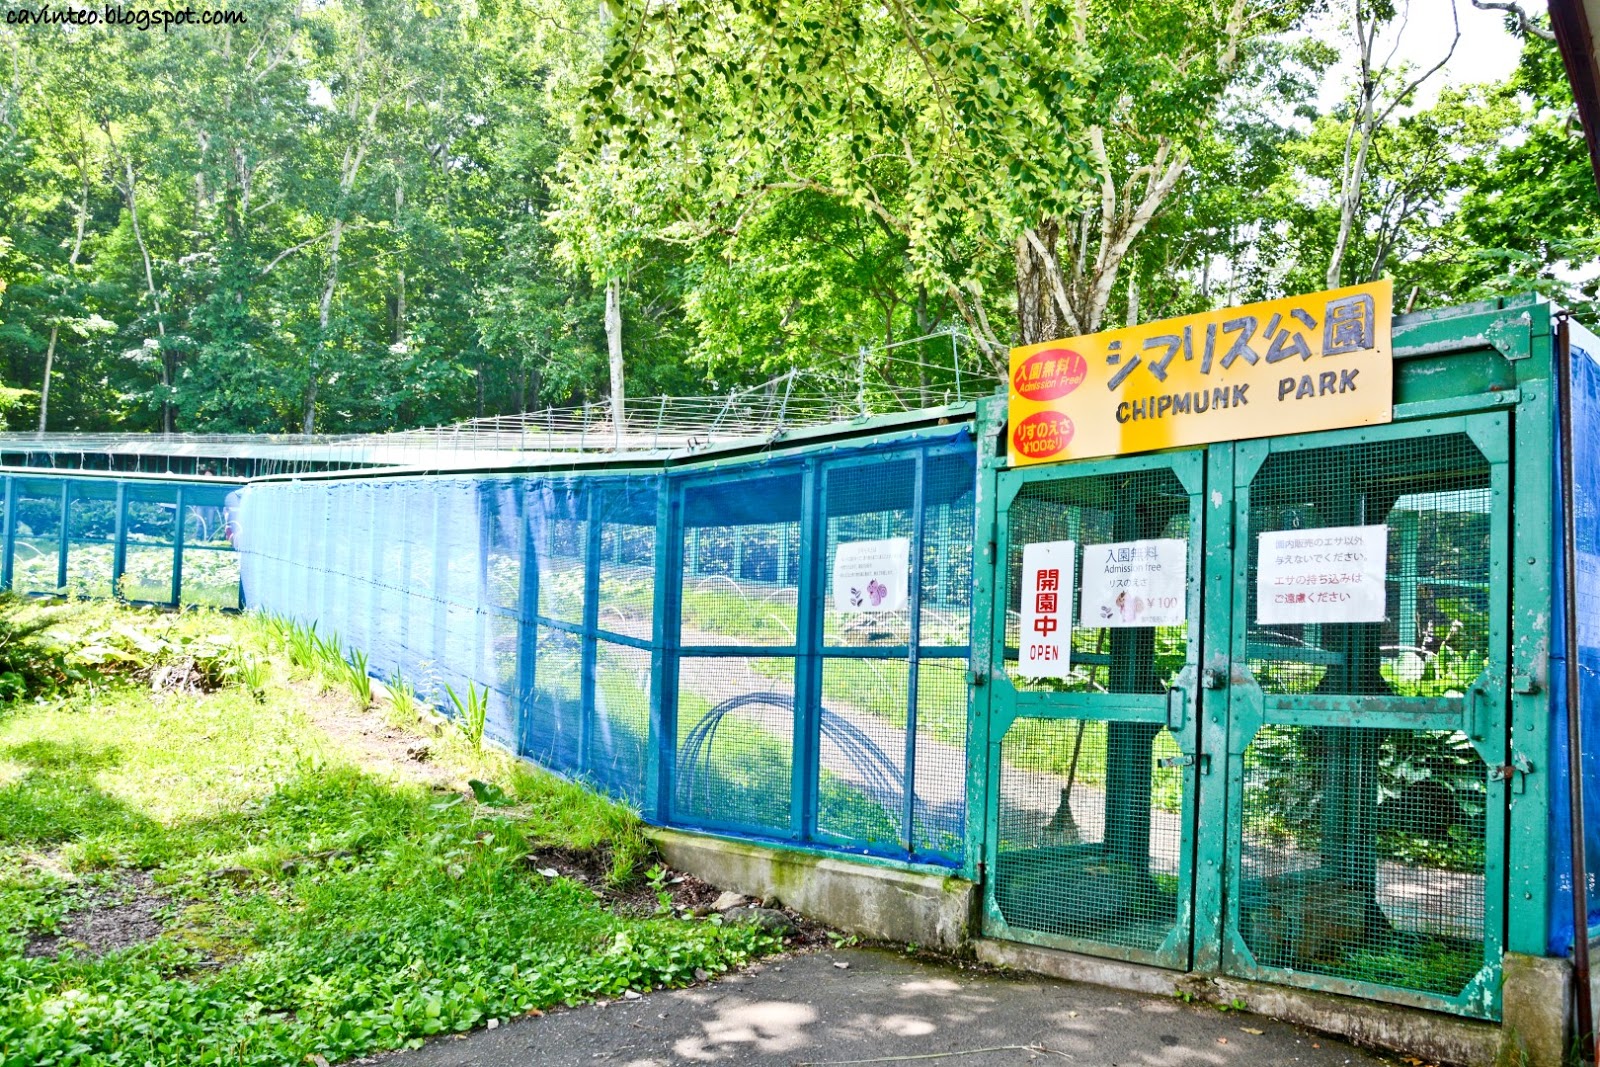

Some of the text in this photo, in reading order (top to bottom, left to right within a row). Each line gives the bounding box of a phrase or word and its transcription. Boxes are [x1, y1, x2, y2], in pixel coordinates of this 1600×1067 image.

[1105, 293, 1375, 391] シマリス公園
[1019, 379, 1057, 393] Admission
[1115, 368, 1360, 424] CHIPMUNK PARK
[1017, 418, 1070, 441] りすのえさ
[1105, 545, 1159, 563] 入園無料
[1275, 552, 1368, 565] 与えないでください。
[1104, 564, 1143, 574] Admission
[1109, 578, 1148, 588] リスのえさ
[1274, 573, 1362, 586] エサの持ち込みは
[1033, 568, 1060, 638] 開園中
[1274, 592, 1351, 604] ご遠慮ください
[1030, 644, 1059, 661] OPEN
